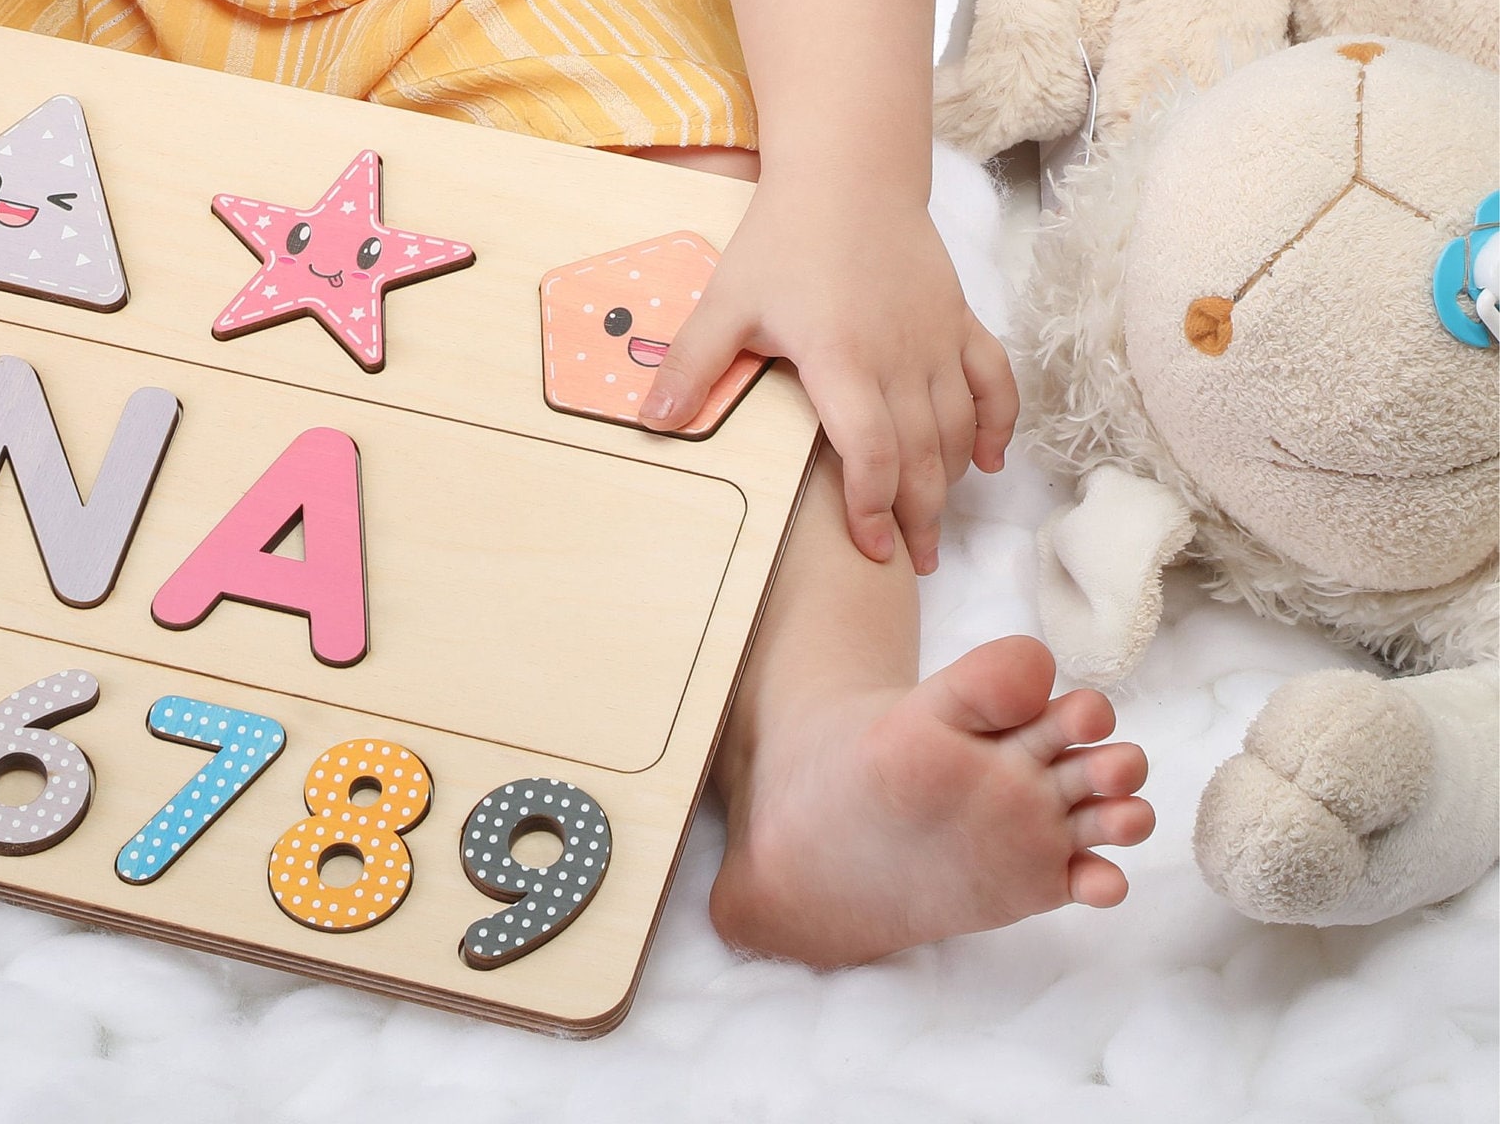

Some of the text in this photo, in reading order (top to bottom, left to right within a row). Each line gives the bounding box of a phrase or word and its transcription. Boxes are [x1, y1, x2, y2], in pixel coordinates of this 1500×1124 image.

[114, 694, 288, 886] 7
[267, 737, 434, 933] 8
[457, 776, 613, 972] 9
